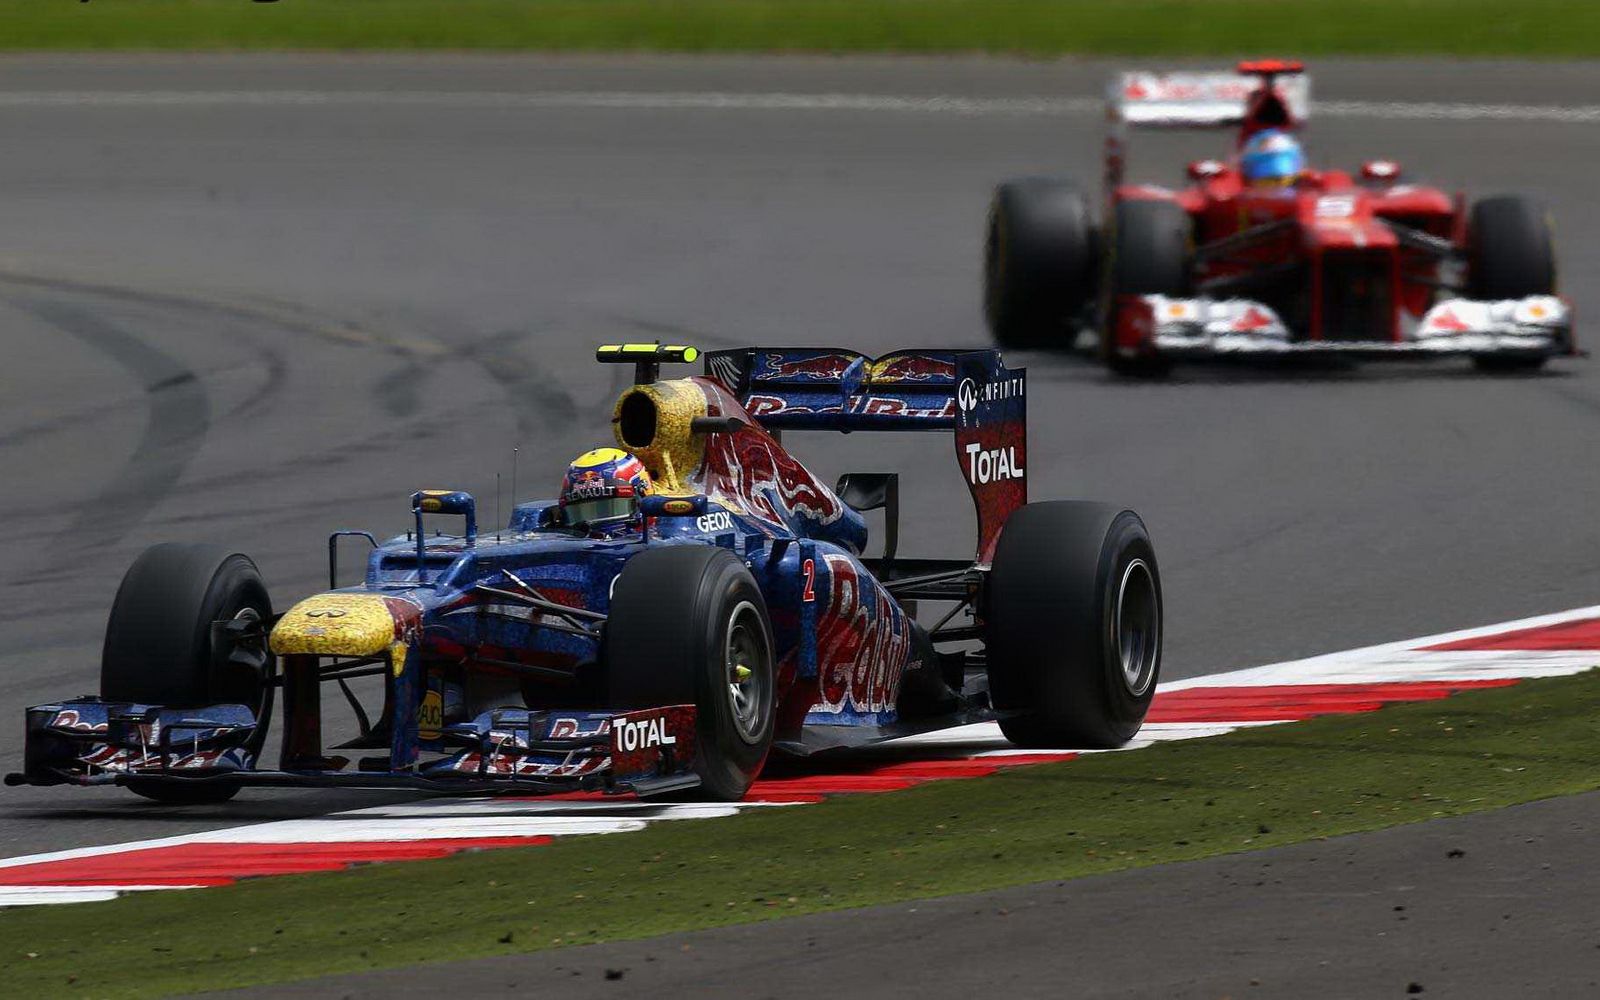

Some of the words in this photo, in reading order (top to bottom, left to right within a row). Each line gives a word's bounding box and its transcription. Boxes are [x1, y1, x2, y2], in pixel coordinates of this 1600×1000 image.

[966, 443, 1023, 485] TOTAL
[696, 511, 733, 533] GEOX
[803, 558, 815, 602] 2
[613, 717, 676, 752] TOTAL
